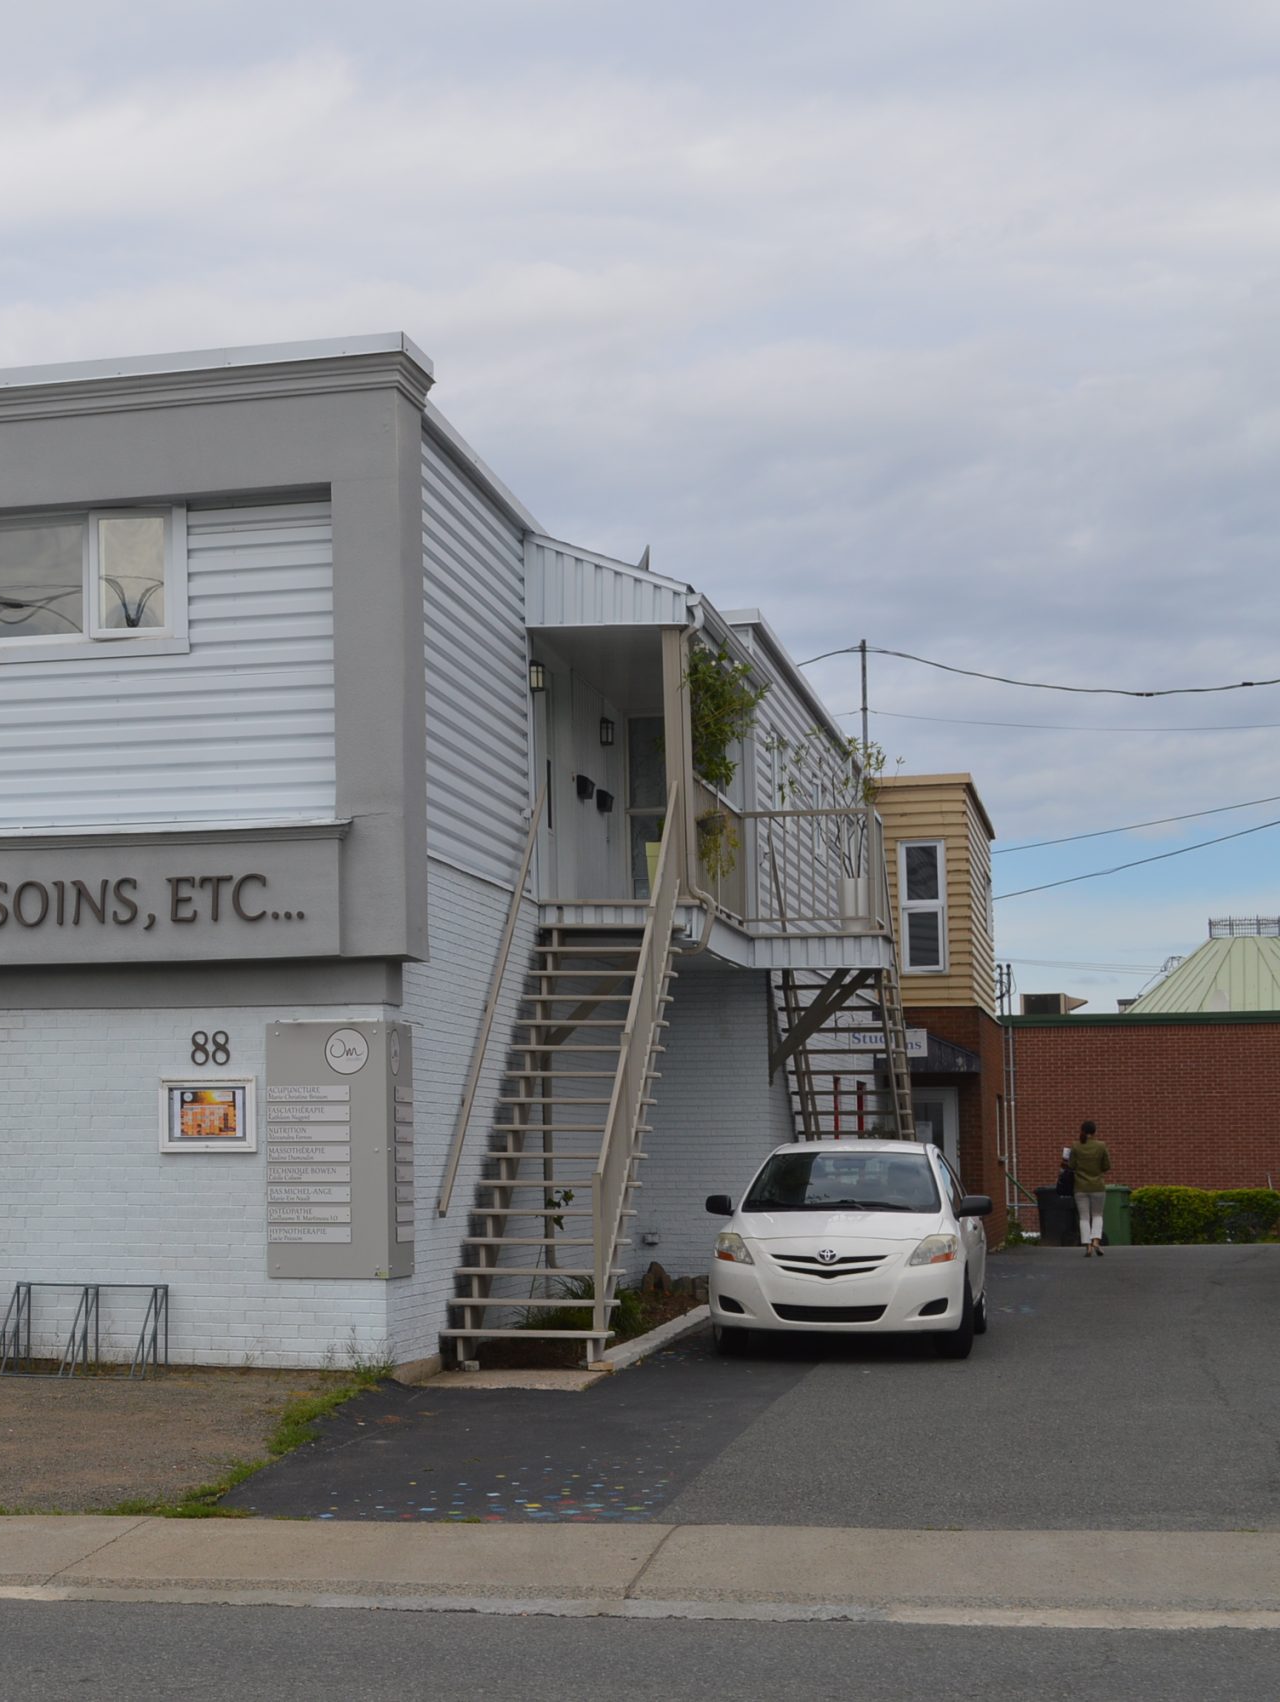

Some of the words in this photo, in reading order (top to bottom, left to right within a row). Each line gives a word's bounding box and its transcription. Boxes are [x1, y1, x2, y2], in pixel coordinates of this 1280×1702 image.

[190, 1030, 231, 1067] 88
[329, 1038, 364, 1059] Om
[268, 1086, 321, 1094] ACUPUNCTURE
[268, 1167, 310, 1175] TECHNIQUE
